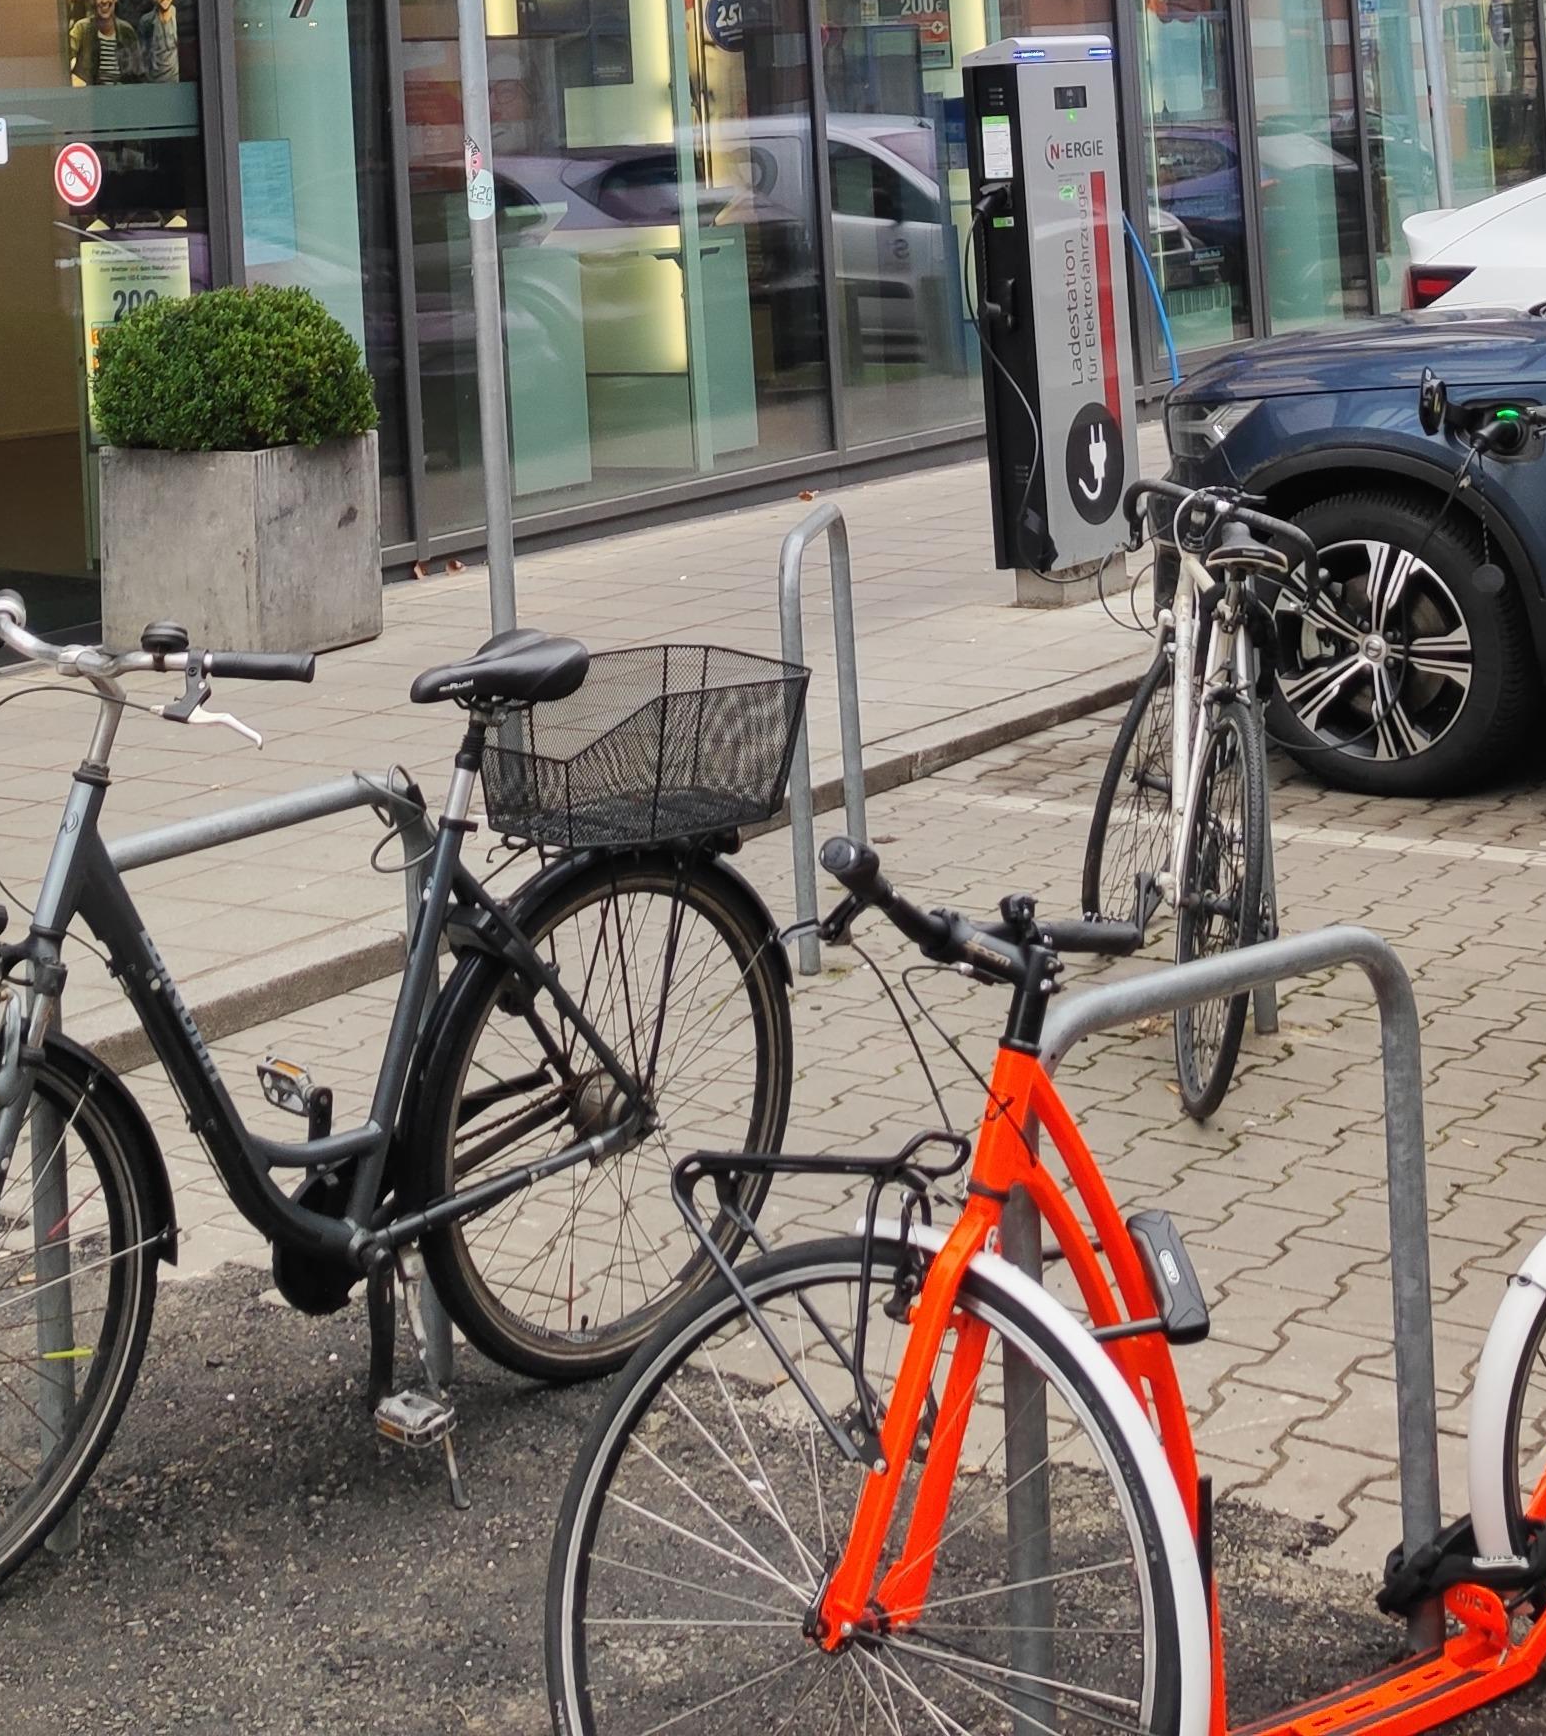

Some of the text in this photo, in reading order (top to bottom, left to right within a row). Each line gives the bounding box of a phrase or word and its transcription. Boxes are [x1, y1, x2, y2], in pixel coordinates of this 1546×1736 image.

[1049, 140, 1104, 160] N-ERGIE
[1064, 238, 1084, 387] Ladestation
[1078, 183, 1096, 348] Elektrofahrzeuge
